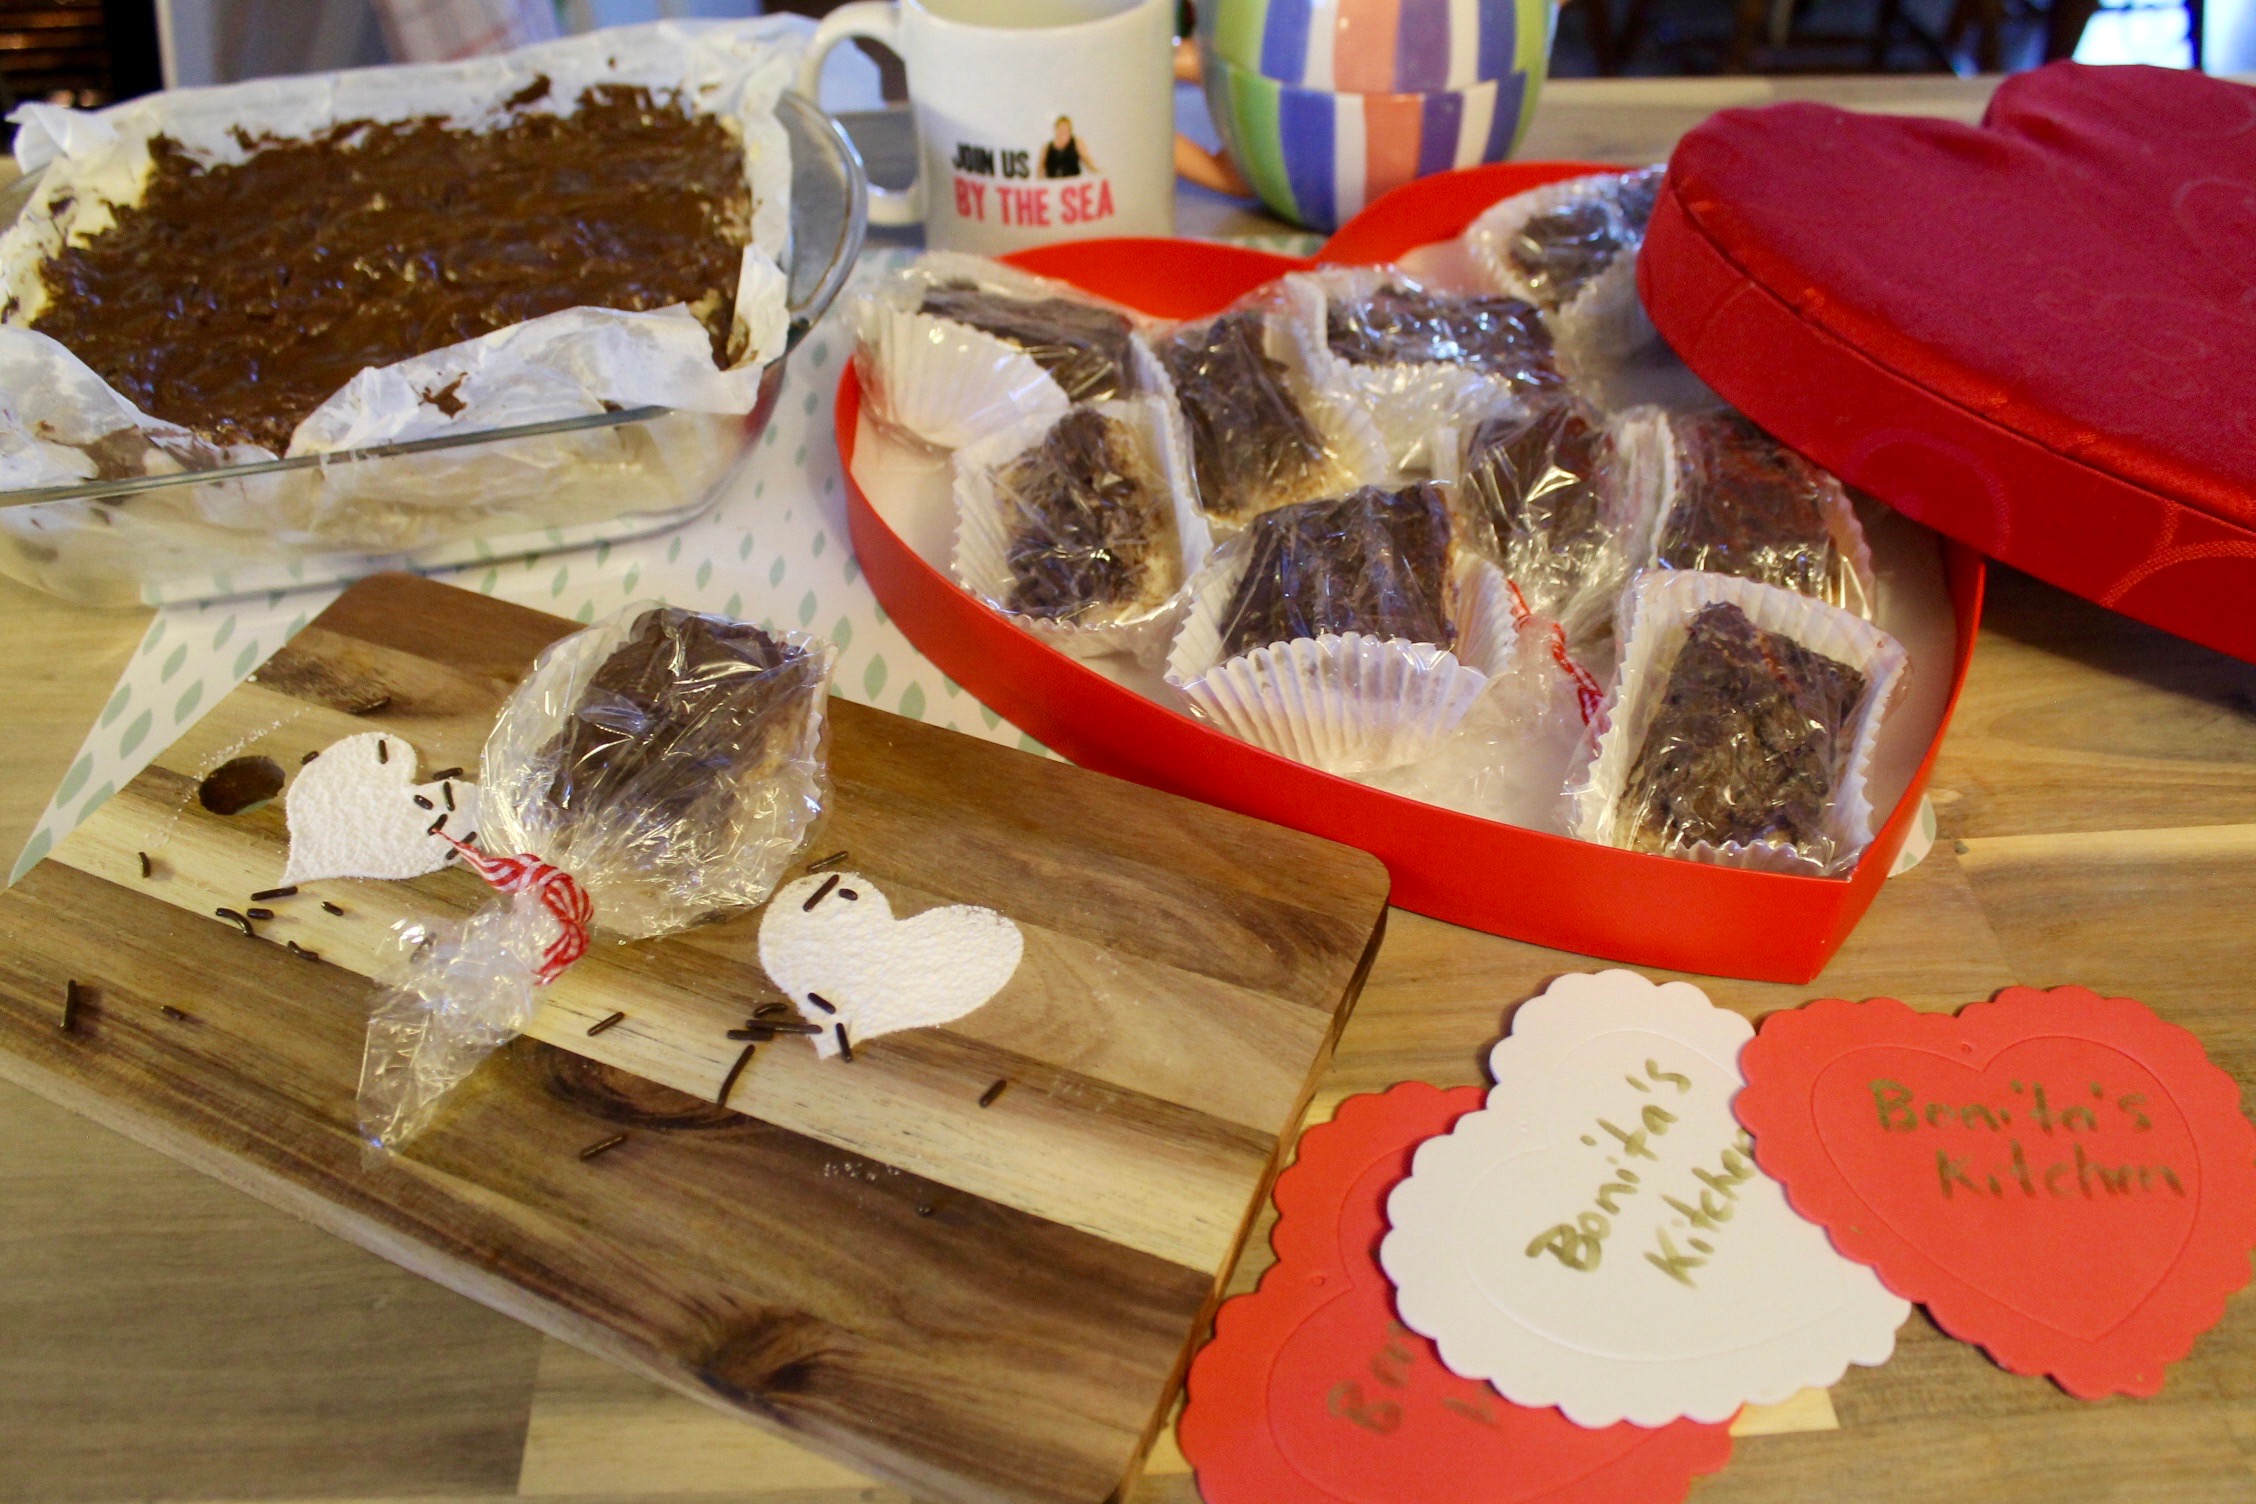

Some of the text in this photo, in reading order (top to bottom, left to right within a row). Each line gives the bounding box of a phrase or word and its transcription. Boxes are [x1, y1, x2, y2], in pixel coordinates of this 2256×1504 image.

[953, 142, 1031, 179] JOIN US
[954, 177, 1115, 226] BY THE SEA
[1868, 1078, 2153, 1137] Bonita's
[1525, 1058, 1692, 1273] Bonita's
[1936, 1138, 2187, 1201] Kitchen
